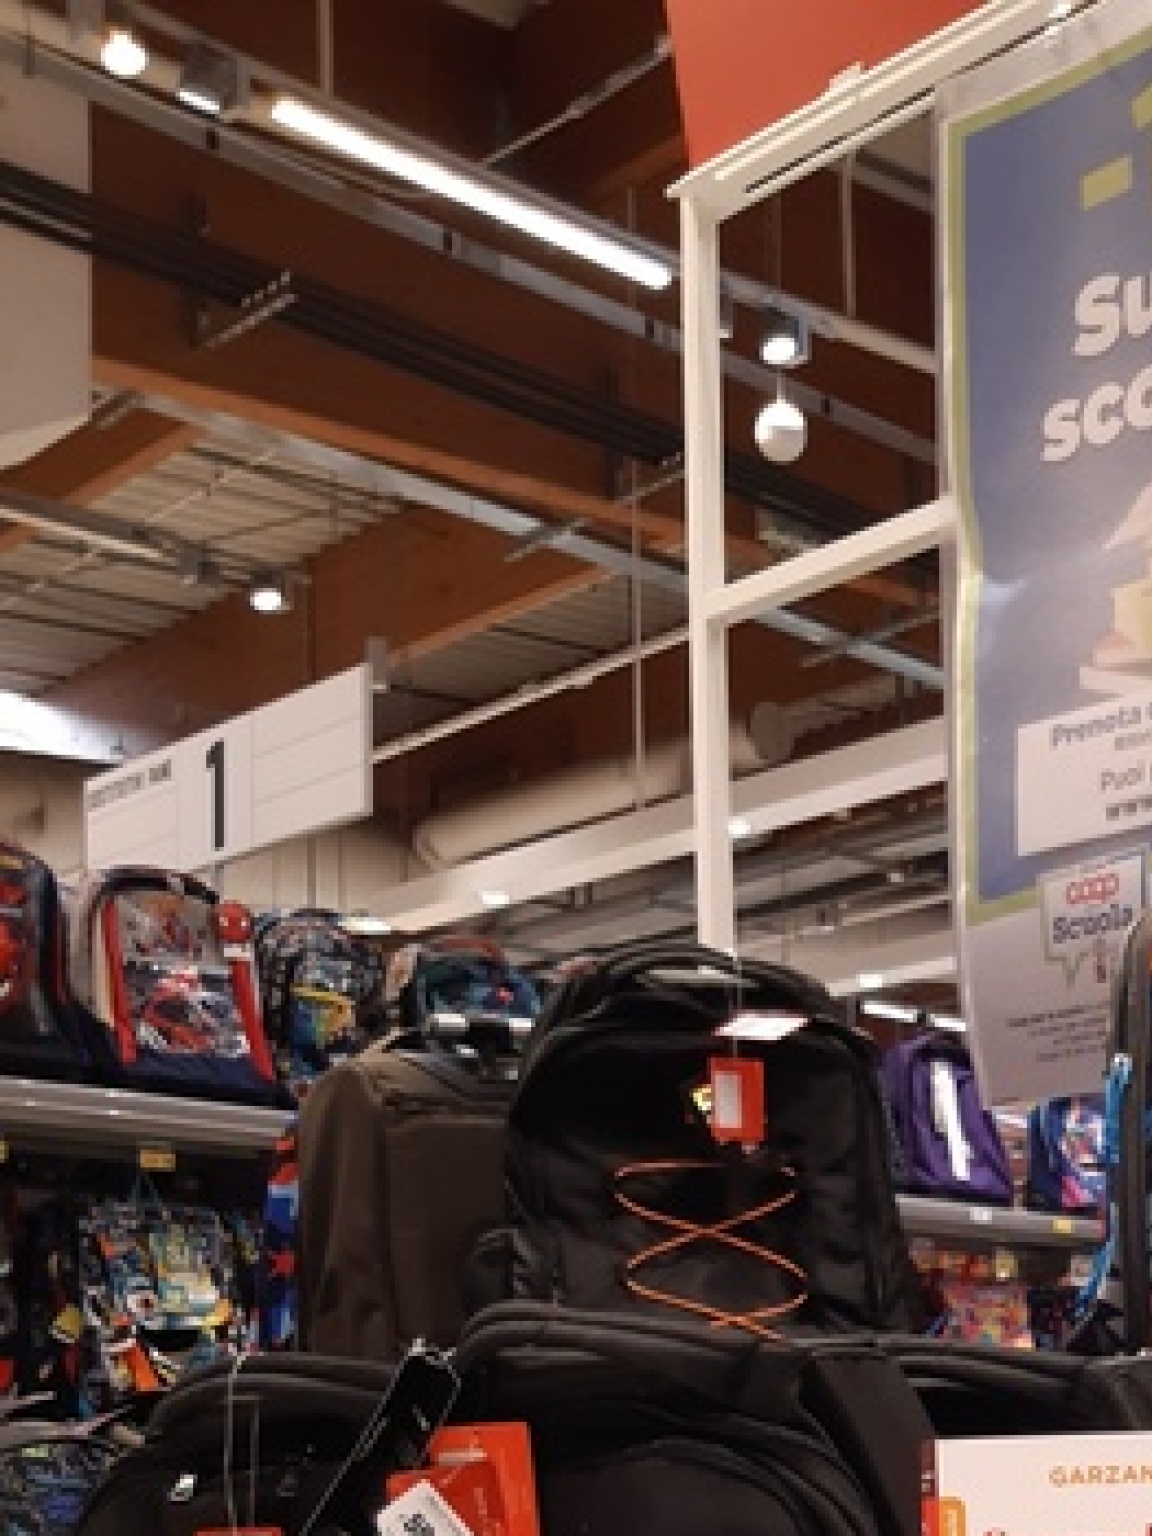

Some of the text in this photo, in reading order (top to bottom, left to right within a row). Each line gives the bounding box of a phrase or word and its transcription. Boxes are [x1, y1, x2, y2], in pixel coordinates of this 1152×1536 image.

[1050, 706, 1142, 748] Prenota
[205, 738, 226, 851] 1
[1099, 760, 1145, 793] Puoi
